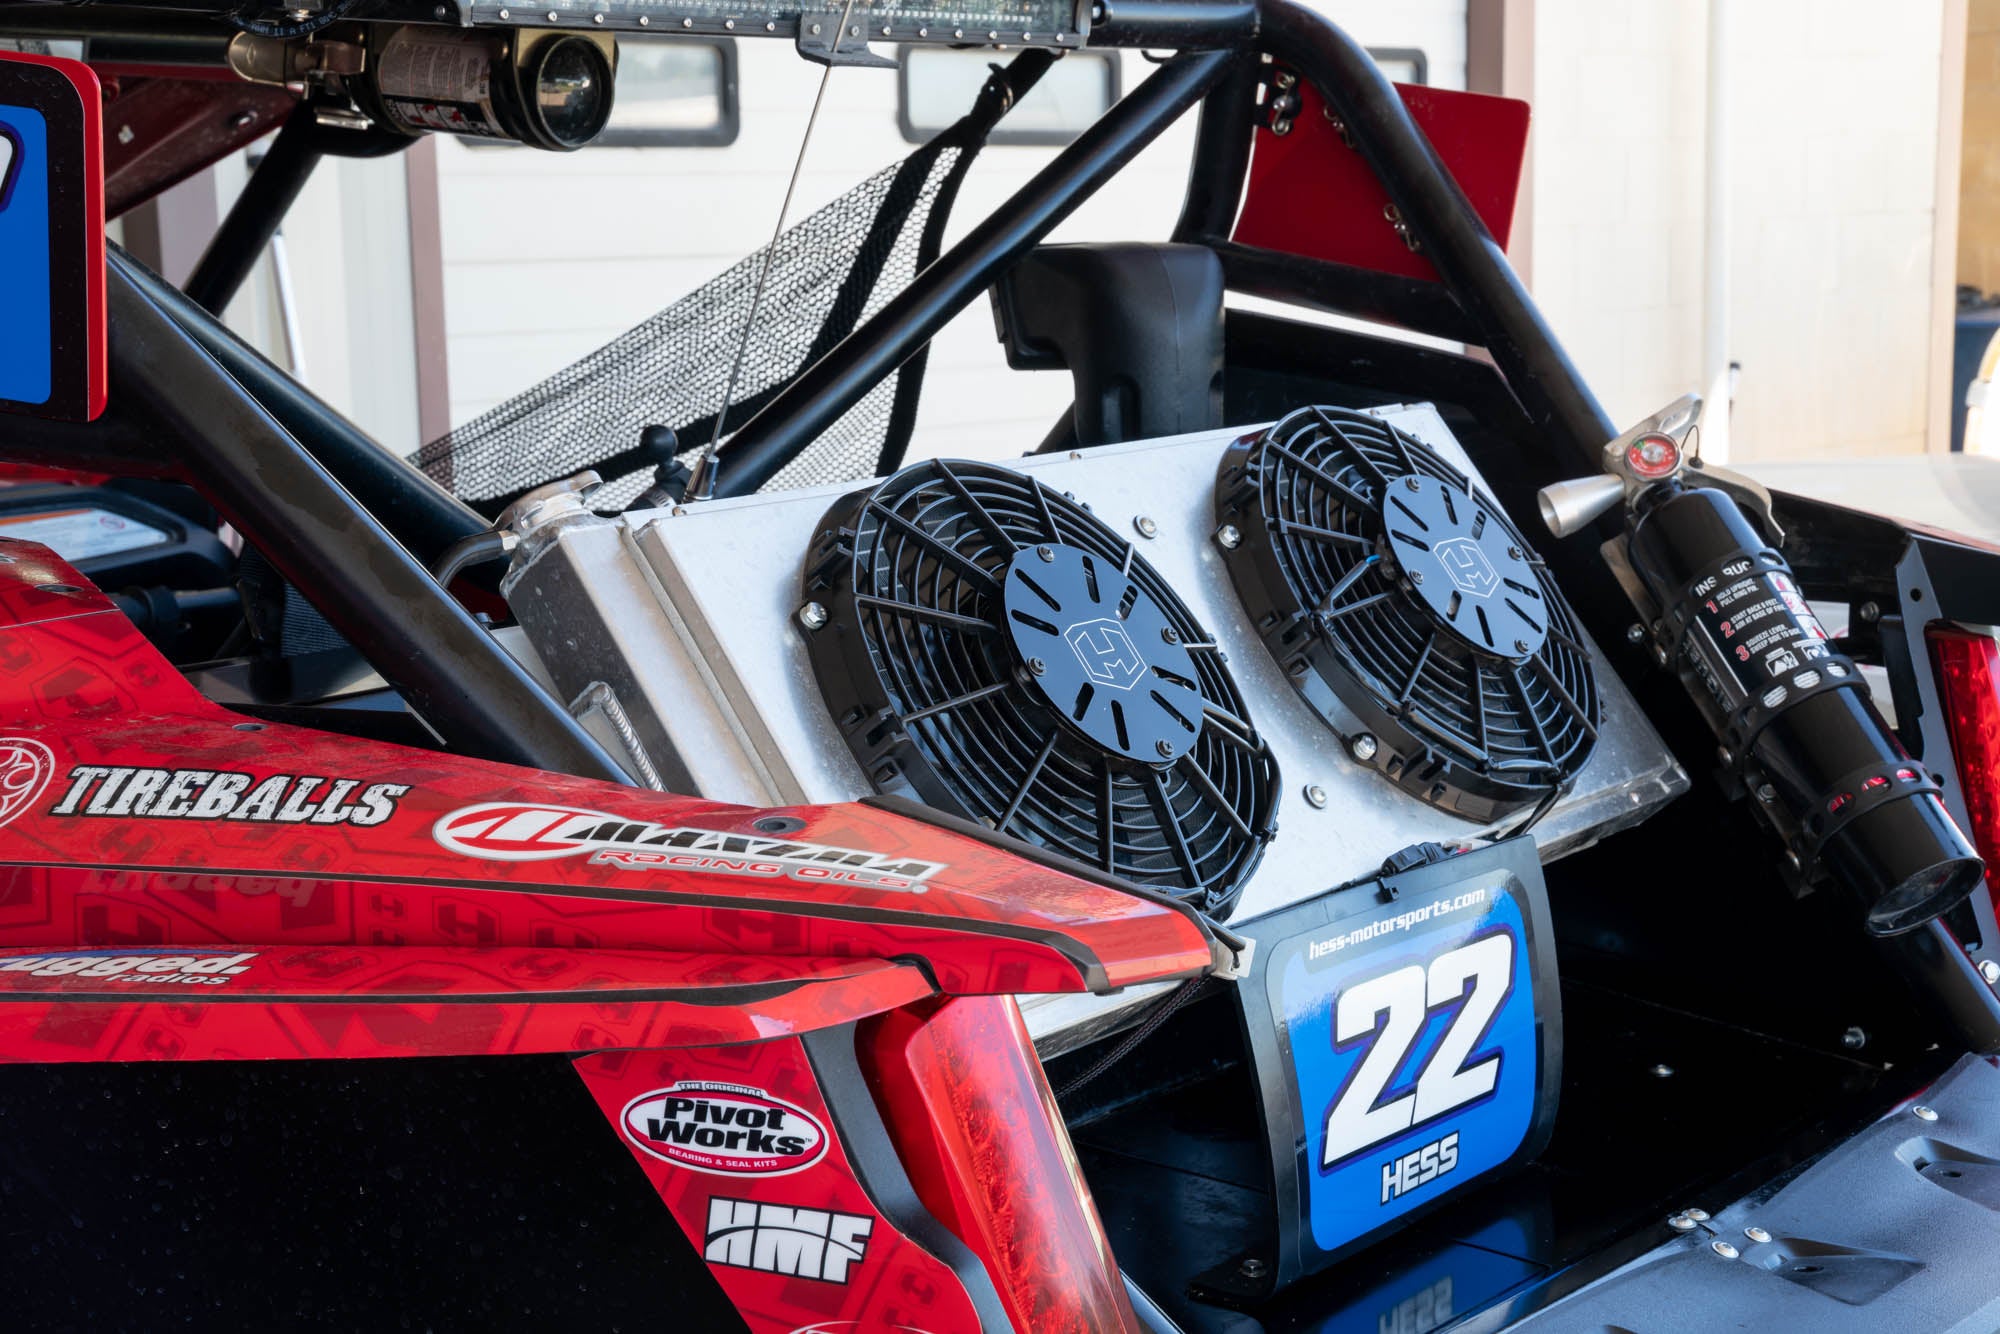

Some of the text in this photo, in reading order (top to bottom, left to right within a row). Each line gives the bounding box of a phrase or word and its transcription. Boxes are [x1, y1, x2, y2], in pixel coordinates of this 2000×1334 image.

[1705, 599, 1719, 614] 1
[1720, 595, 1735, 607] PULL
[1730, 610, 1748, 624] START
[1746, 603, 1762, 615] BACK
[1745, 615, 1754, 624] AT
[1751, 609, 1768, 620] BASE
[1765, 606, 1774, 615] OF
[1720, 620, 1735, 638] 2
[1745, 630, 1770, 648] SQUEEZE
[1750, 639, 1769, 654] SWEEP
[1780, 630, 1790, 639] TO
[1735, 645, 1750, 661] 3
[49, 764, 413, 827] TIREBALLS
[599, 850, 913, 889] RACING OILS
[1309, 889, 1485, 960] hess-motorsports.com
[105, 972, 232, 985] radios
[1322, 932, 1514, 1168] 22
[678, 1082, 766, 1098] THE ORIGINAL
[664, 1096, 787, 1131] Pivot
[647, 1118, 806, 1156] Works
[668, 1147, 712, 1164] BEARING
[725, 1160, 752, 1168] SEAL
[753, 1159, 778, 1168] KITS
[1380, 1130, 1460, 1207] HESS
[703, 1197, 875, 1285] HMF
